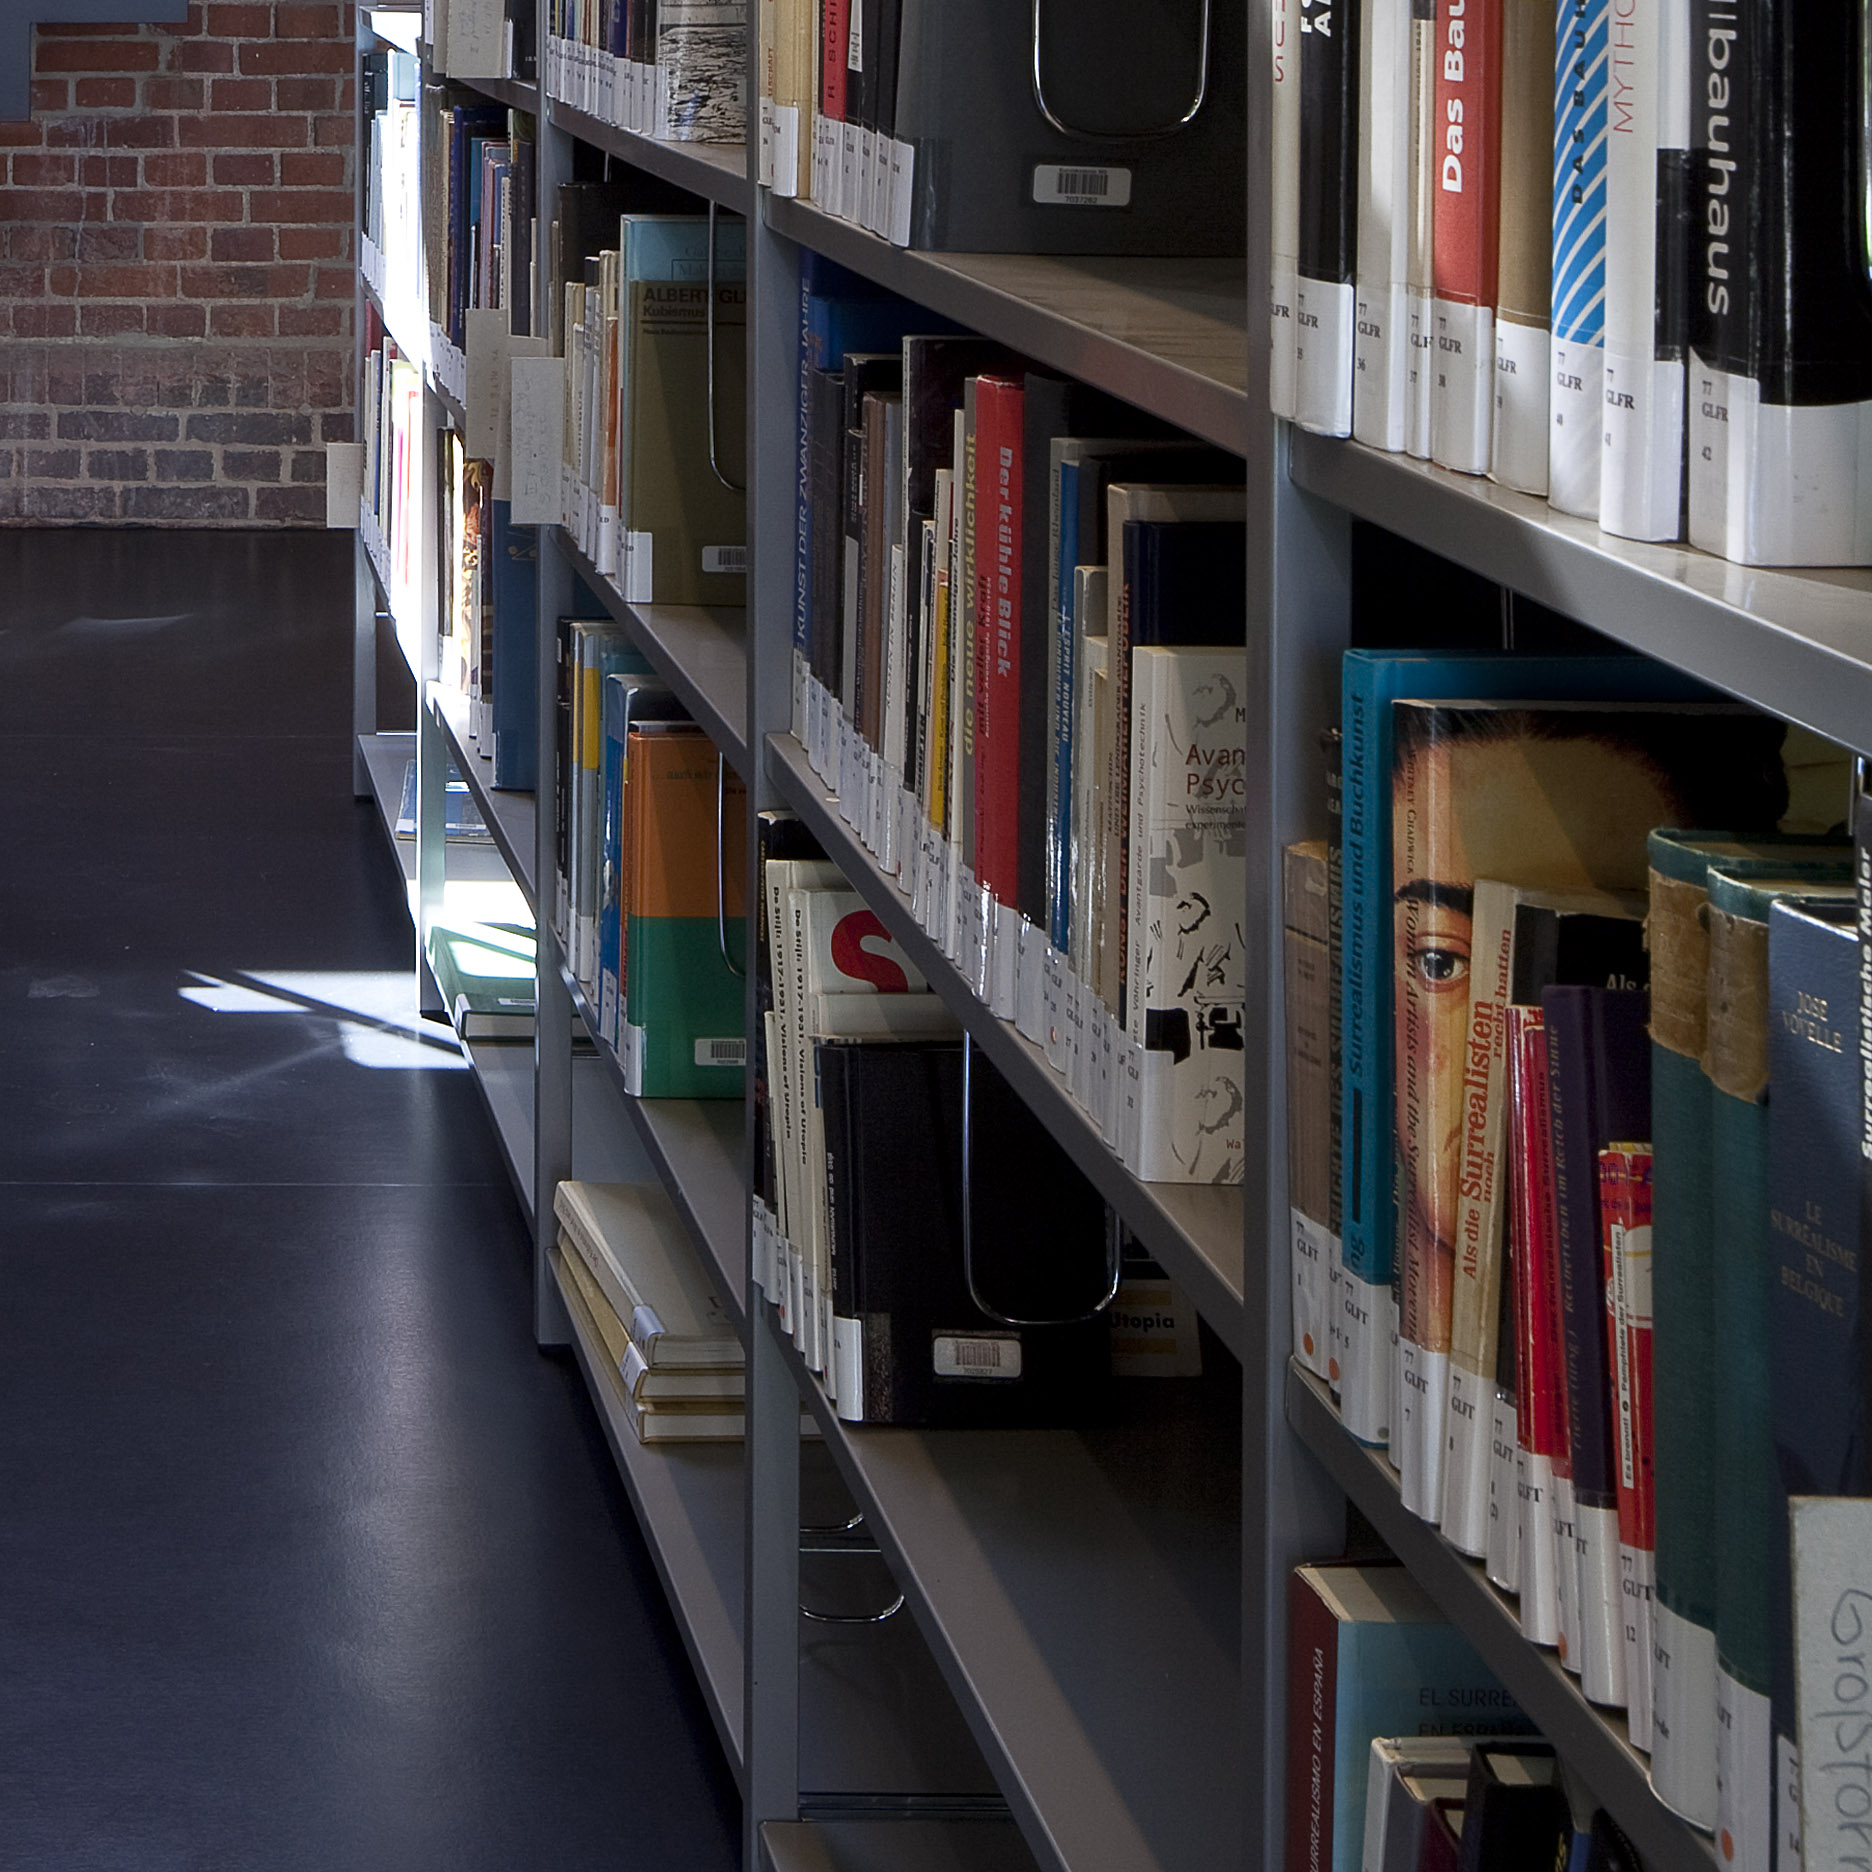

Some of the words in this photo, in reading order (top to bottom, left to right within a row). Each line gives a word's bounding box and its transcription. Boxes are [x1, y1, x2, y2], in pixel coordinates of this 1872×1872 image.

[1439, 96, 1466, 194] Das
[1569, 128, 1585, 206] DAS
[642, 285, 711, 305] ALBERT
[797, 275, 813, 366] JAHRE
[796, 369, 811, 504] ZWANZIGER
[998, 445, 1013, 501] Der
[960, 432, 979, 609] wirklichkeit
[997, 504, 1013, 594] kühle
[793, 560, 810, 640] KUNST
[977, 574, 989, 628] Kraft
[995, 595, 1011, 676] Blick
[963, 619, 975, 698] neue
[962, 711, 975, 757] die
[1136, 702, 1147, 806] Psychotechnik
[1349, 690, 1367, 838] Buchkunst
[1351, 841, 1366, 896] und
[1405, 808, 1417, 875] CHADWICK
[1133, 843, 1144, 926] Avantgarde
[1132, 939, 1142, 1011] Vöhringer
[1349, 900, 1366, 1080] Surrealismus
[1495, 928, 1513, 999] hatten
[1490, 1003, 1507, 1060] recht
[1460, 999, 1495, 1203] Surrealisten
[1484, 1151, 1494, 1203] noch
[1465, 1208, 1480, 1242] die
[1558, 1205, 1575, 1313] Recherchen
[1463, 1245, 1478, 1280] Als
[1110, 1312, 1175, 1331] Utopia
[1625, 1624, 1636, 1642] 12
[1312, 1646, 1326, 1718] ESPAÑA
[1419, 1687, 1443, 1706] EL
